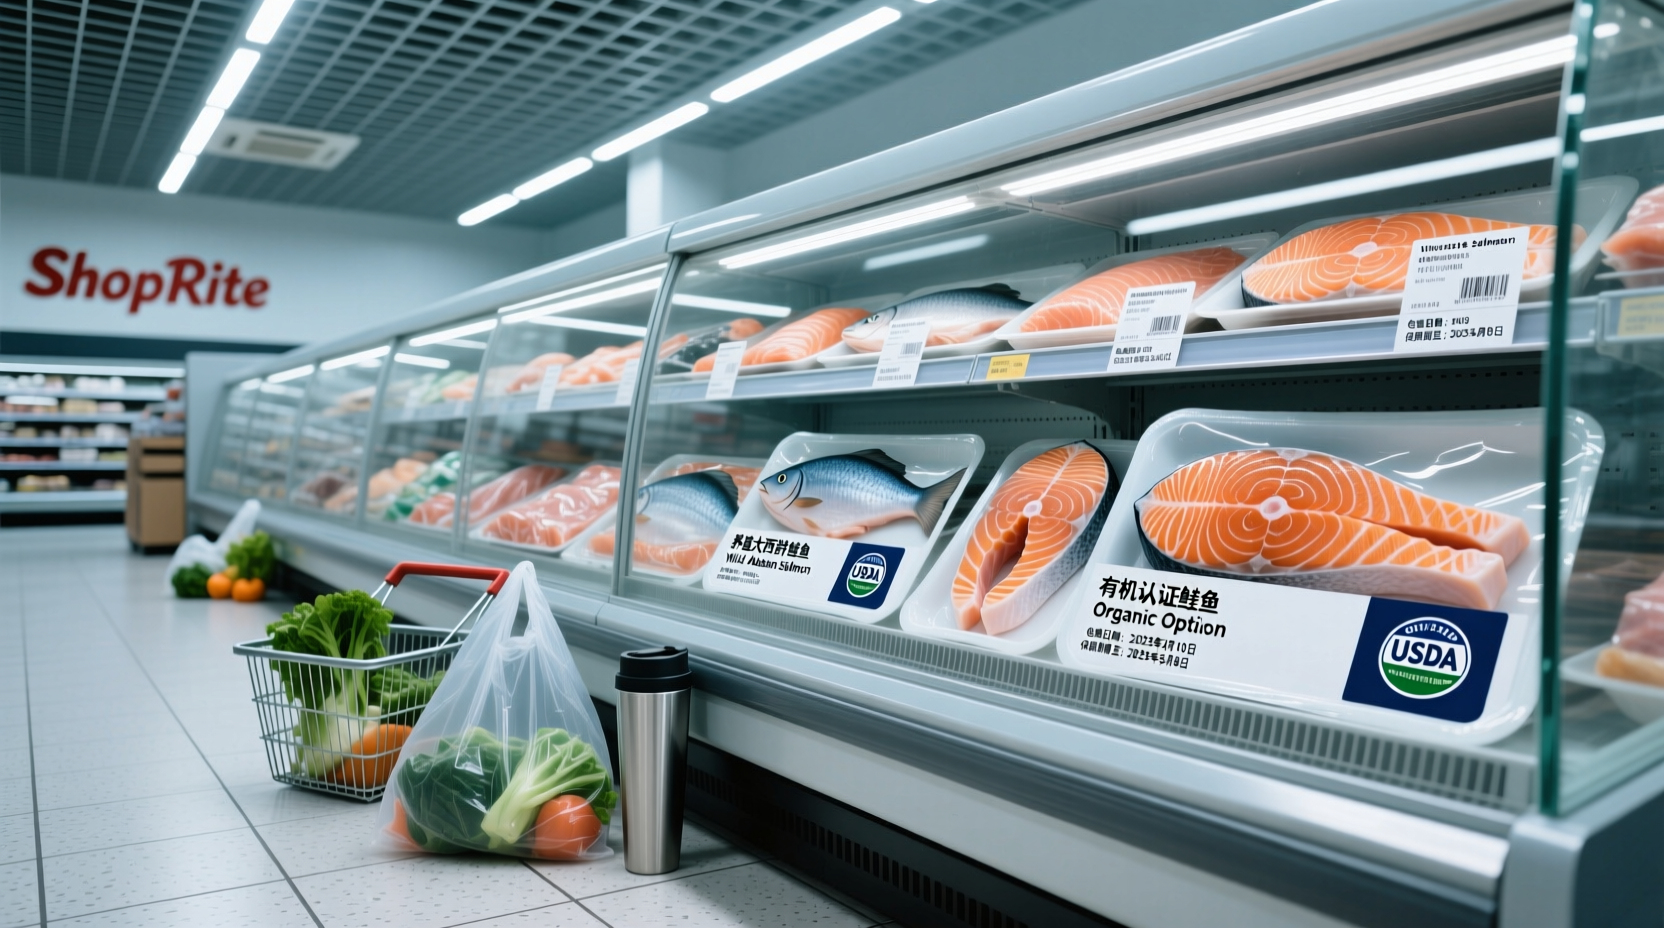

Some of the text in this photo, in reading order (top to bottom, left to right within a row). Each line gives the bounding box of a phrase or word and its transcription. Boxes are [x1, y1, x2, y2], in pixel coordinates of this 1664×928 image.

[24, 247, 270, 314] ShopRite
[1099, 575, 1219, 614] 有机认证鲑鱼
[1093, 601, 1158, 625] Organic
[1391, 638, 1457, 672] USDA
